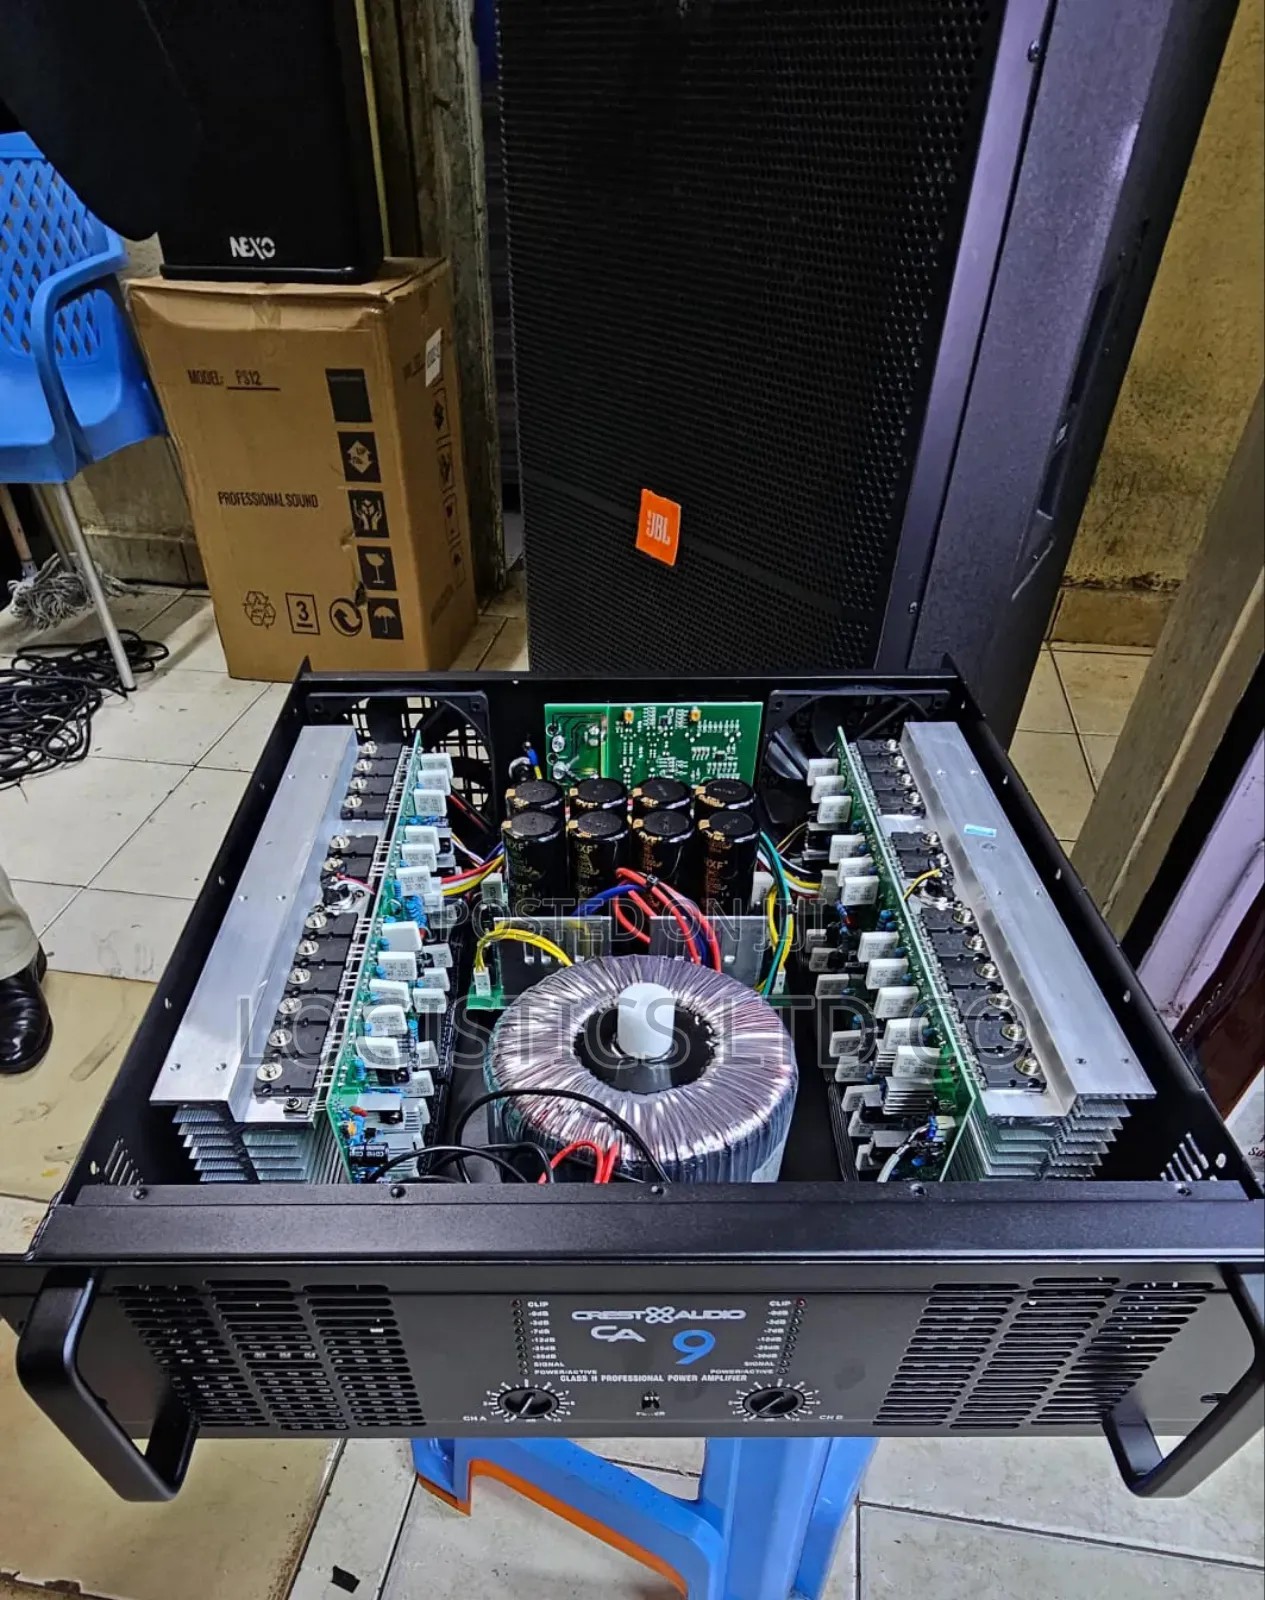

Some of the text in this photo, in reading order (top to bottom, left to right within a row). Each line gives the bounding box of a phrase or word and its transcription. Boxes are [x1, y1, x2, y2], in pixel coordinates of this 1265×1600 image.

[229, 236, 276, 260] NEXO
[187, 369, 224, 386] MODEL:
[217, 490, 319, 508] PROFESSIONAL SOUND
[645, 509, 671, 546] JBL
[296, 600, 309, 621] 3
[571, 1309, 747, 1320] CREST AUDIO
[590, 1325, 716, 1365] CA 9
